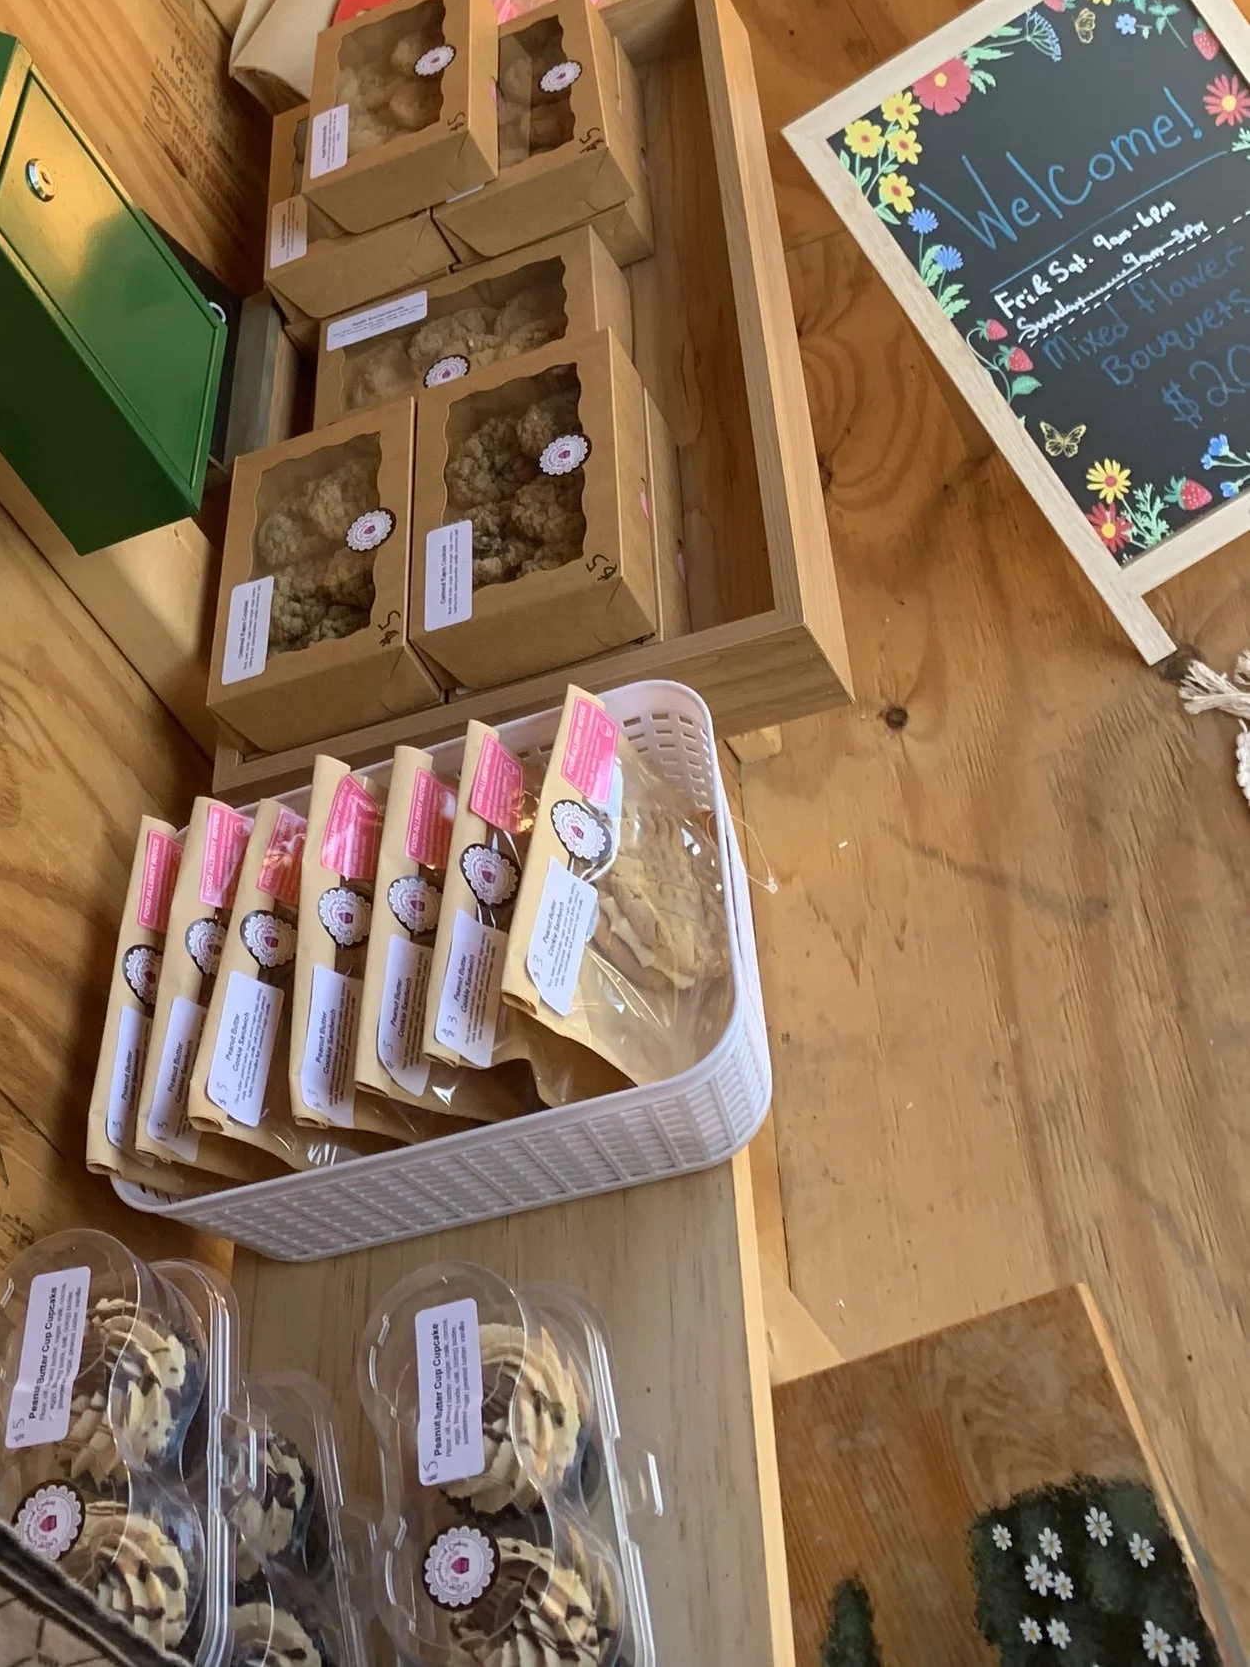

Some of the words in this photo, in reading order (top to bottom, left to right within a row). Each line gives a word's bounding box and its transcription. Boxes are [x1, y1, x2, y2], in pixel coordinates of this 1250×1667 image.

[921, 51, 1204, 270] Welcome!
[1045, 244, 1094, 283] Sat.
[1039, 300, 1130, 374] Mixed
[1129, 226, 1249, 316] flower
[1098, 283, 1250, 392] Bouquets
[211, 813, 220, 839] NOTICE
[409, 832, 418, 852] FOOD
[416, 777, 426, 802] NOTICE
[150, 839, 159, 864] NOTICE
[144, 865, 156, 897] ALLERGY
[142, 898, 151, 918] FOOD
[541, 918, 552, 943] Peanut
[548, 899, 557, 919] Butter
[547, 931, 557, 956] Cookie
[553, 901, 565, 932] Sandwich
[457, 954, 466, 975] Butter
[464, 953, 475, 987] Sandwich
[389, 1001, 399, 1026] Peanut
[394, 977, 403, 1001] Butter
[401, 976, 413, 1011] Sandwich
[453, 974, 462, 1001] Peanut
[460, 987, 469, 1012] Cookie
[225, 1035, 236, 1060] Peanut
[231, 1013, 241, 1034] Butter
[319, 1011, 327, 1033] Butter
[397, 1012, 406, 1038] Cookie
[231, 1045, 242, 1071] Cookie
[238, 1011, 250, 1044] Sandwich
[315, 1034, 324, 1062] Peanut
[322, 1047, 332, 1074] Cookie
[327, 1008, 337, 1045] Sandwich
[124, 1049, 133, 1072] Butter
[167, 1064, 179, 1092] Peanut
[173, 1040, 184, 1064] Butter
[120, 1073, 129, 1099] Peanut
[45, 1286, 59, 1330] Cupcake
[41, 1331, 52, 1353] Cup
[432, 1323, 441, 1366] Cupcake
[36, 1354, 47, 1384] Butter
[434, 1368, 442, 1389] Cup
[28, 1384, 39, 1419] Peanut
